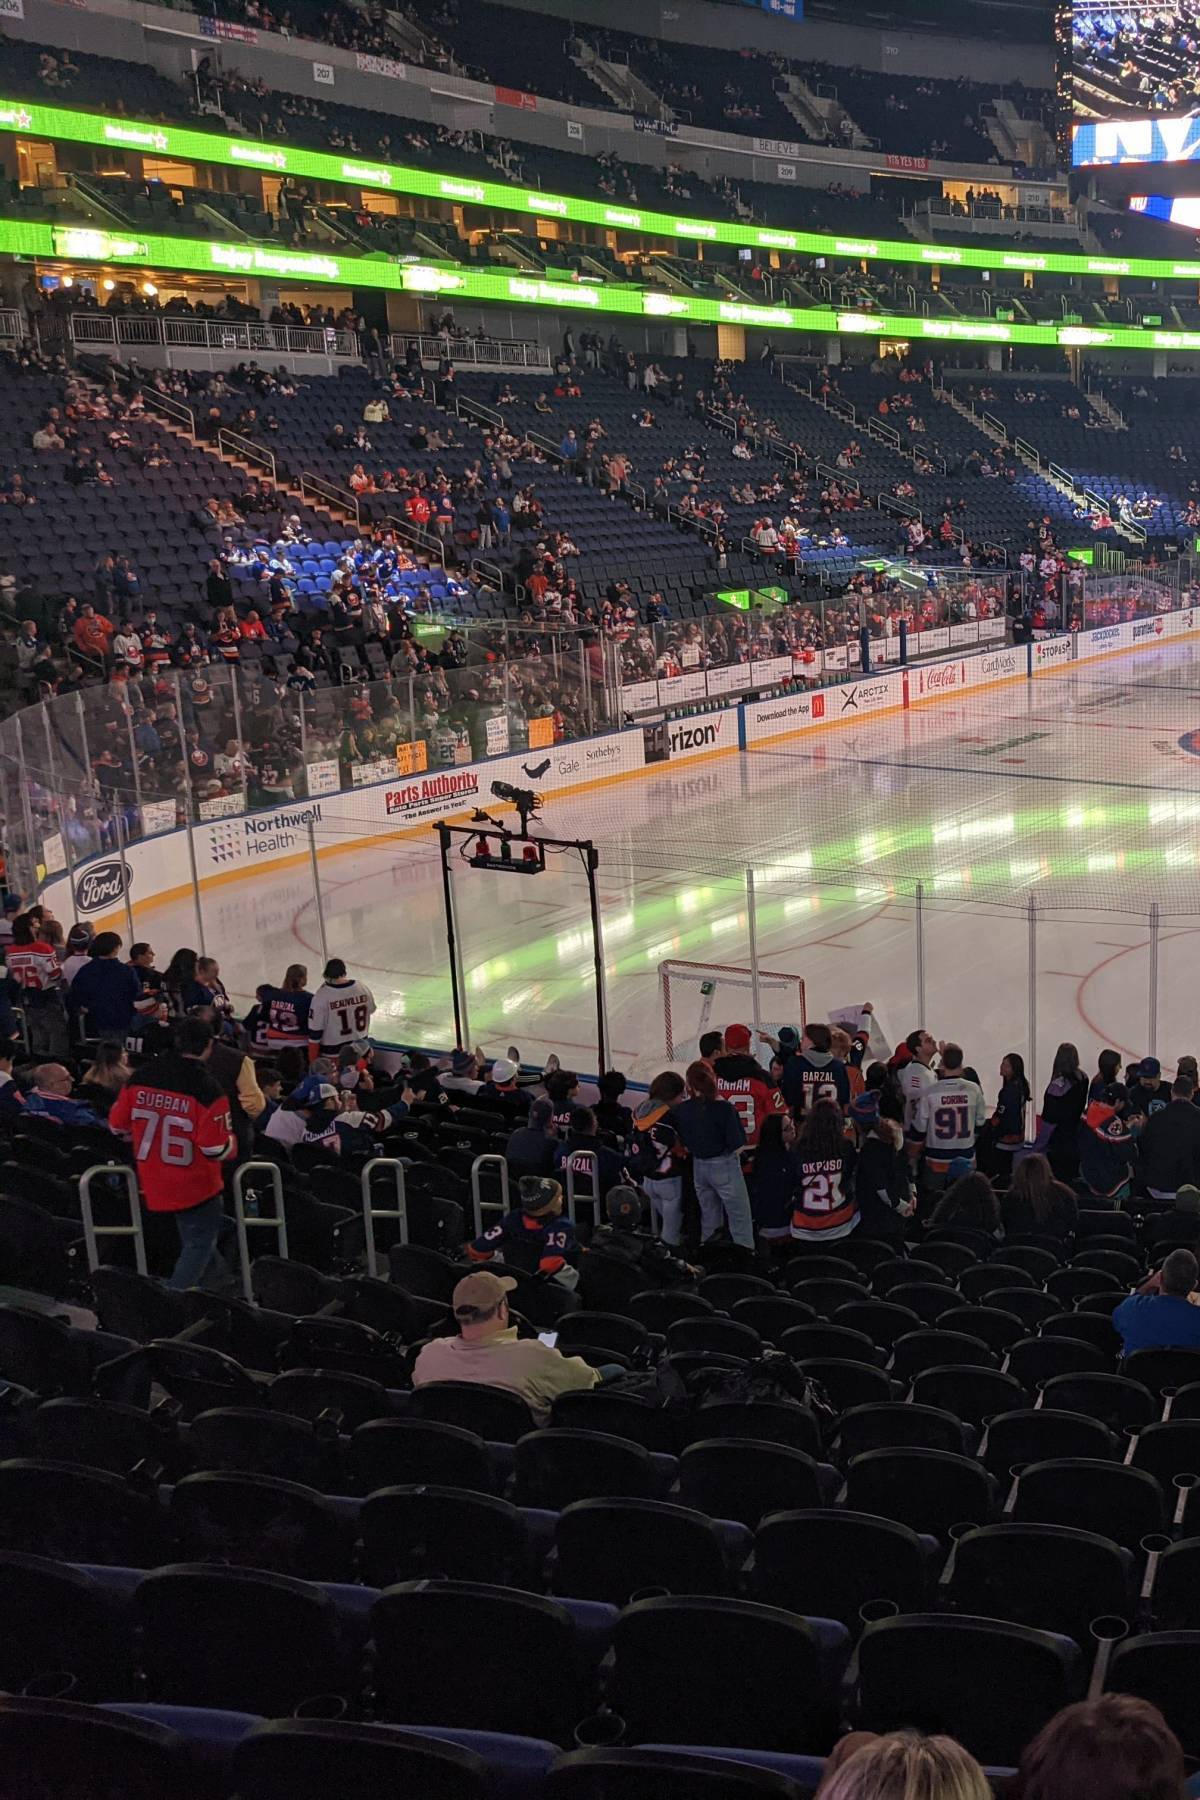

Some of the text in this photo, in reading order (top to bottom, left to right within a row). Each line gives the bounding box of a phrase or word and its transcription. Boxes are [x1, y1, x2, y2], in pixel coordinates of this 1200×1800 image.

[316, 68, 330, 79] 207
[759, 141, 795, 154] BELIEVE
[780, 167, 793, 177] 209
[900, 156, 913, 167] YES
[914, 157, 927, 168] YES
[858, 684, 888, 699] ARCTIX
[756, 703, 810, 723] Download the App
[668, 724, 716, 753] rizon
[586, 744, 622, 761] Sotheby's
[558, 760, 580, 775] Gale
[385, 785, 419, 808] Parts
[421, 771, 478, 798] Authority
[390, 804, 407, 813] Auto
[408, 799, 429, 809] Parts
[453, 787, 477, 798] Stores
[244, 804, 322, 836] Northwell
[418, 805, 442, 816] Answer
[246, 831, 296, 856] Health
[82, 868, 122, 908] Ford
[337, 1004, 368, 1036] 18
[802, 1071, 836, 1083] BARZAL
[135, 1089, 190, 1115] SUBBAN
[941, 1094, 969, 1105] GORING
[934, 1105, 971, 1141] 91
[130, 1107, 194, 1167] 76
[801, 1173, 846, 1211] 21
[547, 1232, 567, 1248] 13
